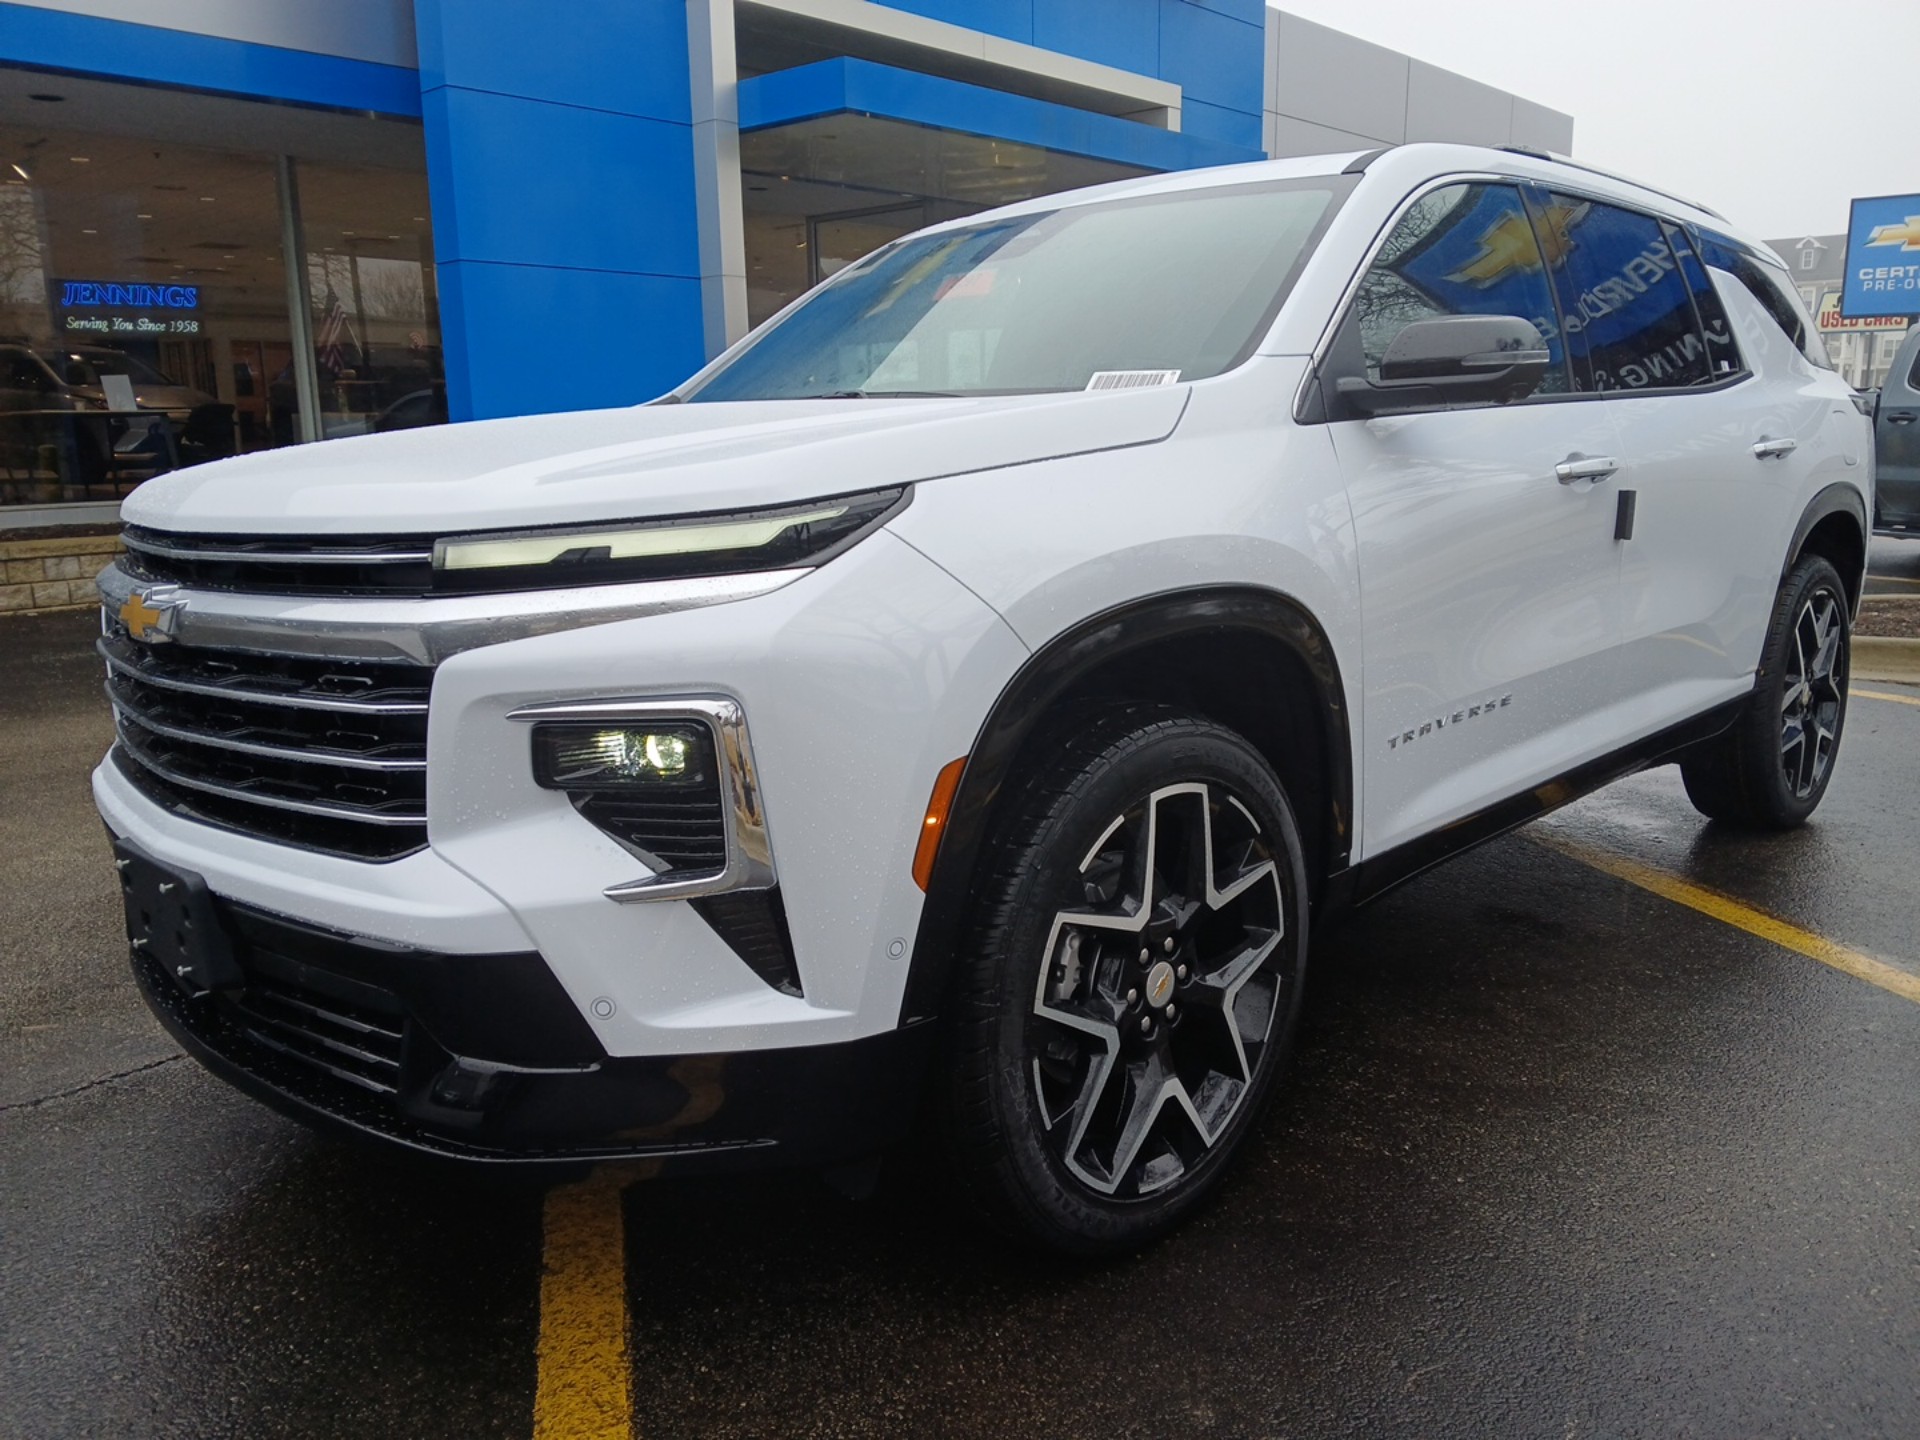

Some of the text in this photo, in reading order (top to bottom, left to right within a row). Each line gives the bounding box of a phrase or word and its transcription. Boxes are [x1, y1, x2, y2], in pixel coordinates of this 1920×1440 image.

[1863, 278, 1920, 291] PRE-O
[61, 282, 197, 309] JENNINGS
[66, 315, 199, 333] Serving You Since 1958
[1820, 311, 1859, 328] USED
[1387, 693, 1513, 750] TRAVERSE
